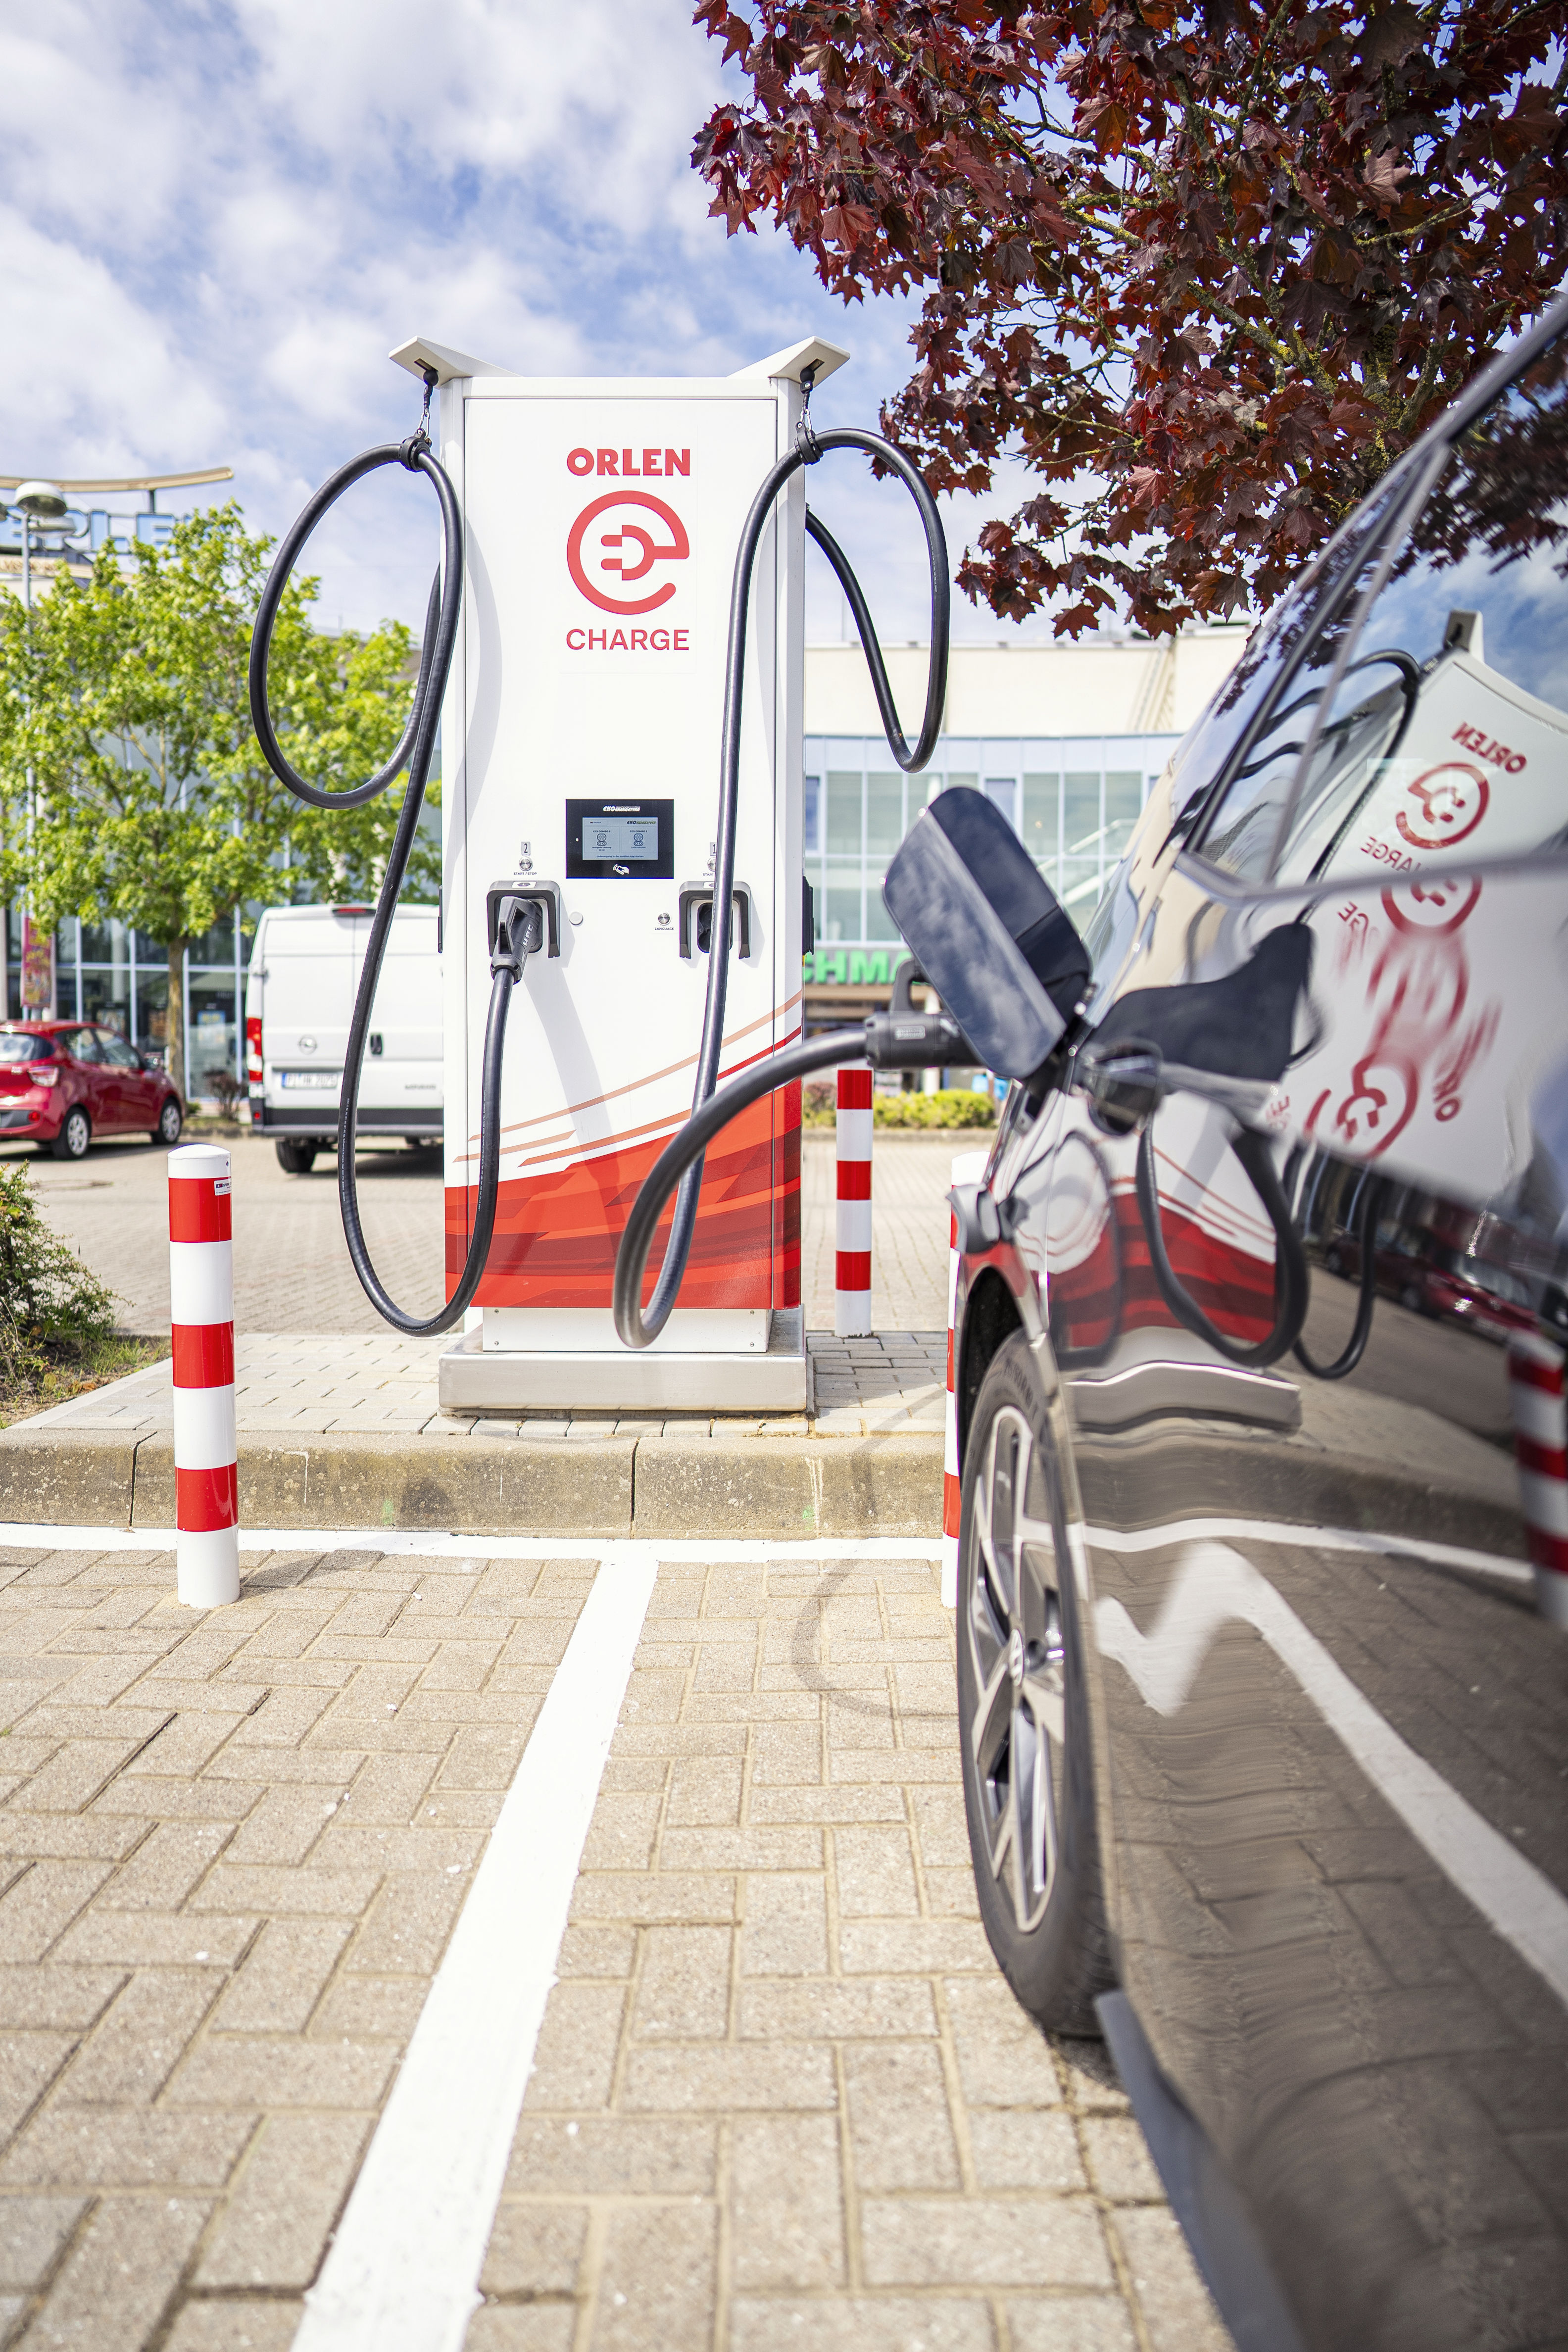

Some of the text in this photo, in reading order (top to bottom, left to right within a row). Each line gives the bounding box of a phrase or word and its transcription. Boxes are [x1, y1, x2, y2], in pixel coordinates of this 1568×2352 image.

[567, 447, 690, 476] ORLEN
[566, 629, 689, 650] CHARGE
[524, 843, 528, 853] 2
[713, 844, 717, 854] 1
